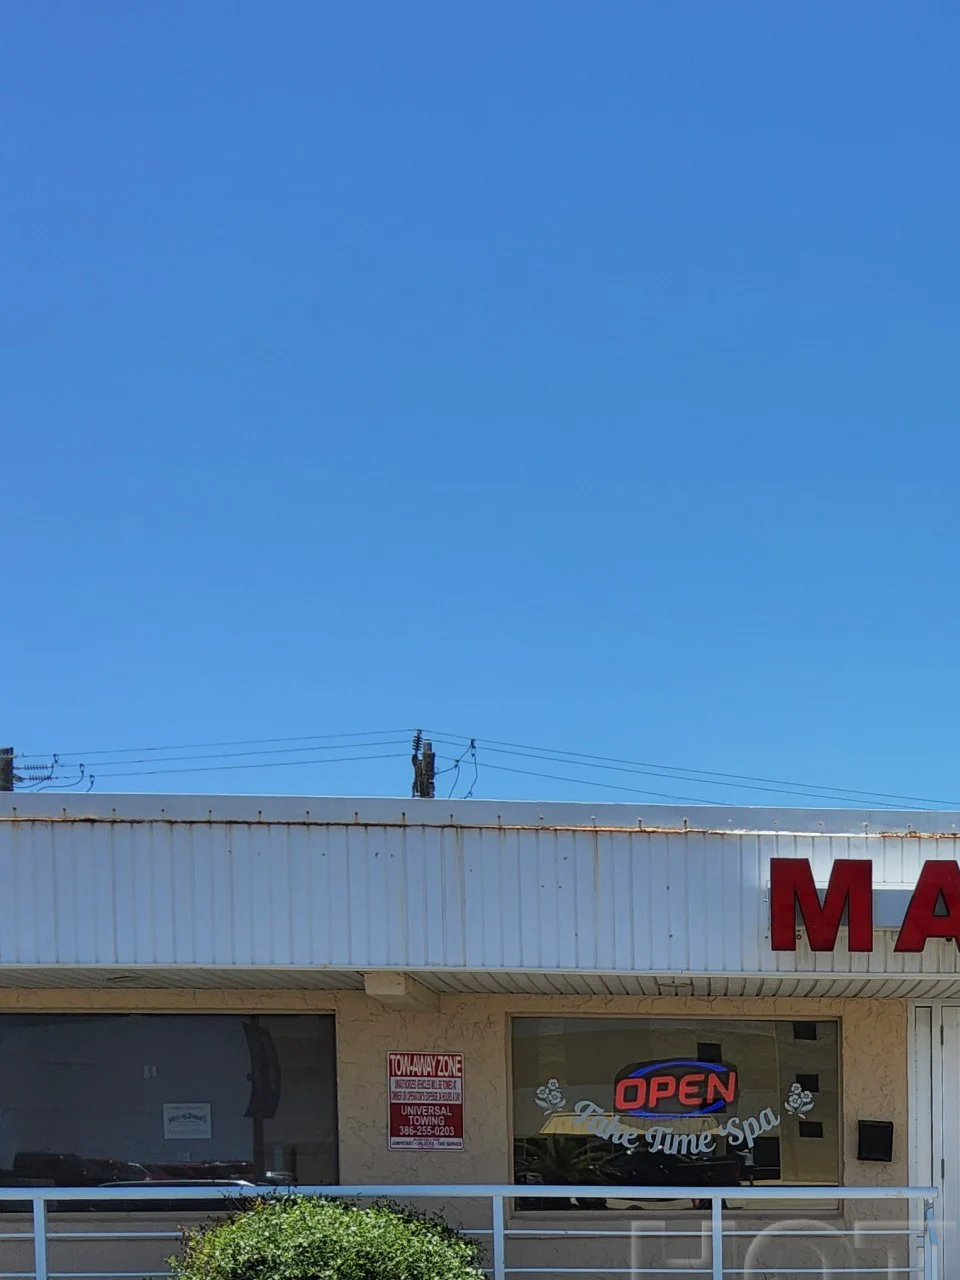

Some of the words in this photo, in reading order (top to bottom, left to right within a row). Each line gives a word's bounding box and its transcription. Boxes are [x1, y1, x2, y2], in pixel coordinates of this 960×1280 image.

[390, 1054, 436, 1076] TOW-AWAY
[437, 1055, 462, 1077] ZONE
[615, 1071, 736, 1111] OPEN
[400, 1105, 453, 1116] UNIVERSAL
[408, 1115, 445, 1126] TOWING
[571, 1100, 640, 1148] Take
[645, 1126, 717, 1155] Time
[716, 1106, 781, 1148] Spa
[399, 1126, 455, 1136] 386-255-0203
